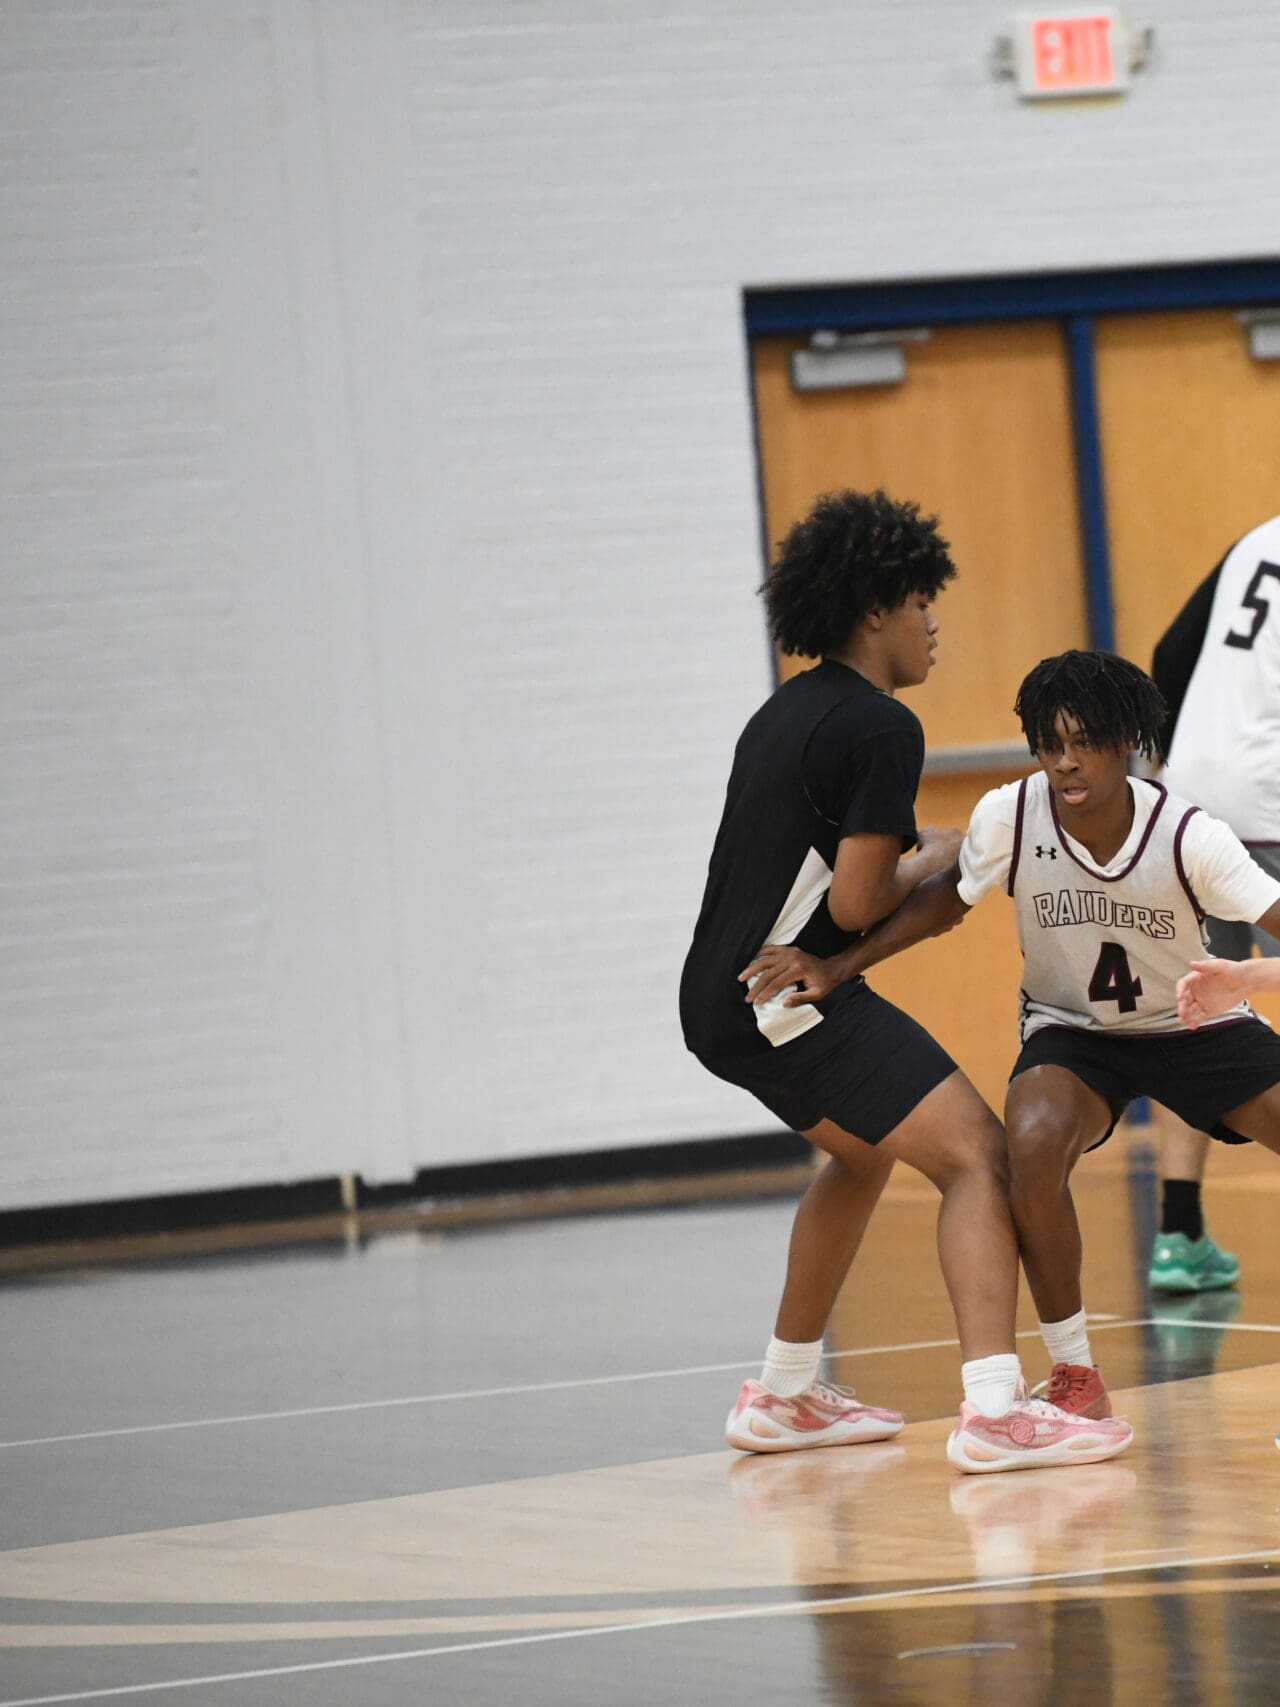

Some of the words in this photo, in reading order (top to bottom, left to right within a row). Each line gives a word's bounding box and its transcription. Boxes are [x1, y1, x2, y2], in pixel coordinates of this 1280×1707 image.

[1033, 16, 1113, 90] EXIT
[1033, 889, 1175, 940] RAIDERS
[1088, 941, 1143, 1014] 4
